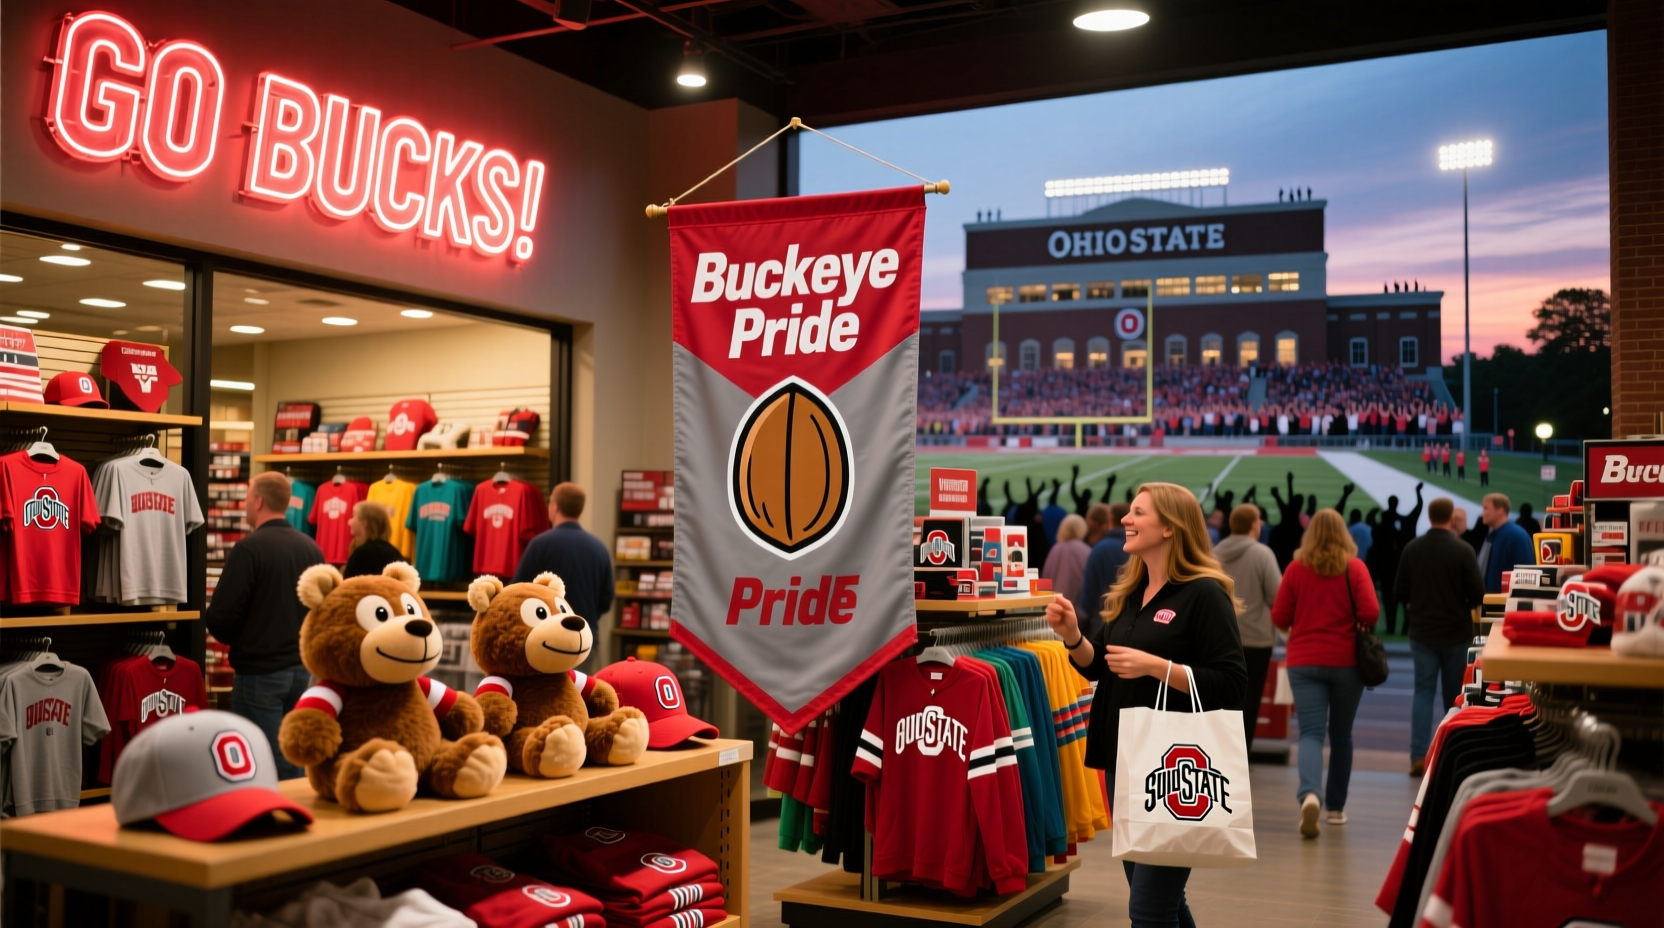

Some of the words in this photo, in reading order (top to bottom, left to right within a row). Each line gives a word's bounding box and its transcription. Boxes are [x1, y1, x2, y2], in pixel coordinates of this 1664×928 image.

[53, 11, 225, 183] GO
[248, 72, 546, 261] BUCKS!
[1047, 229, 1127, 259] OHIO
[1130, 223, 1226, 254] STATE
[690, 243, 900, 307] Buckeye
[728, 299, 860, 359] Pride
[1600, 454, 1664, 483] Buc
